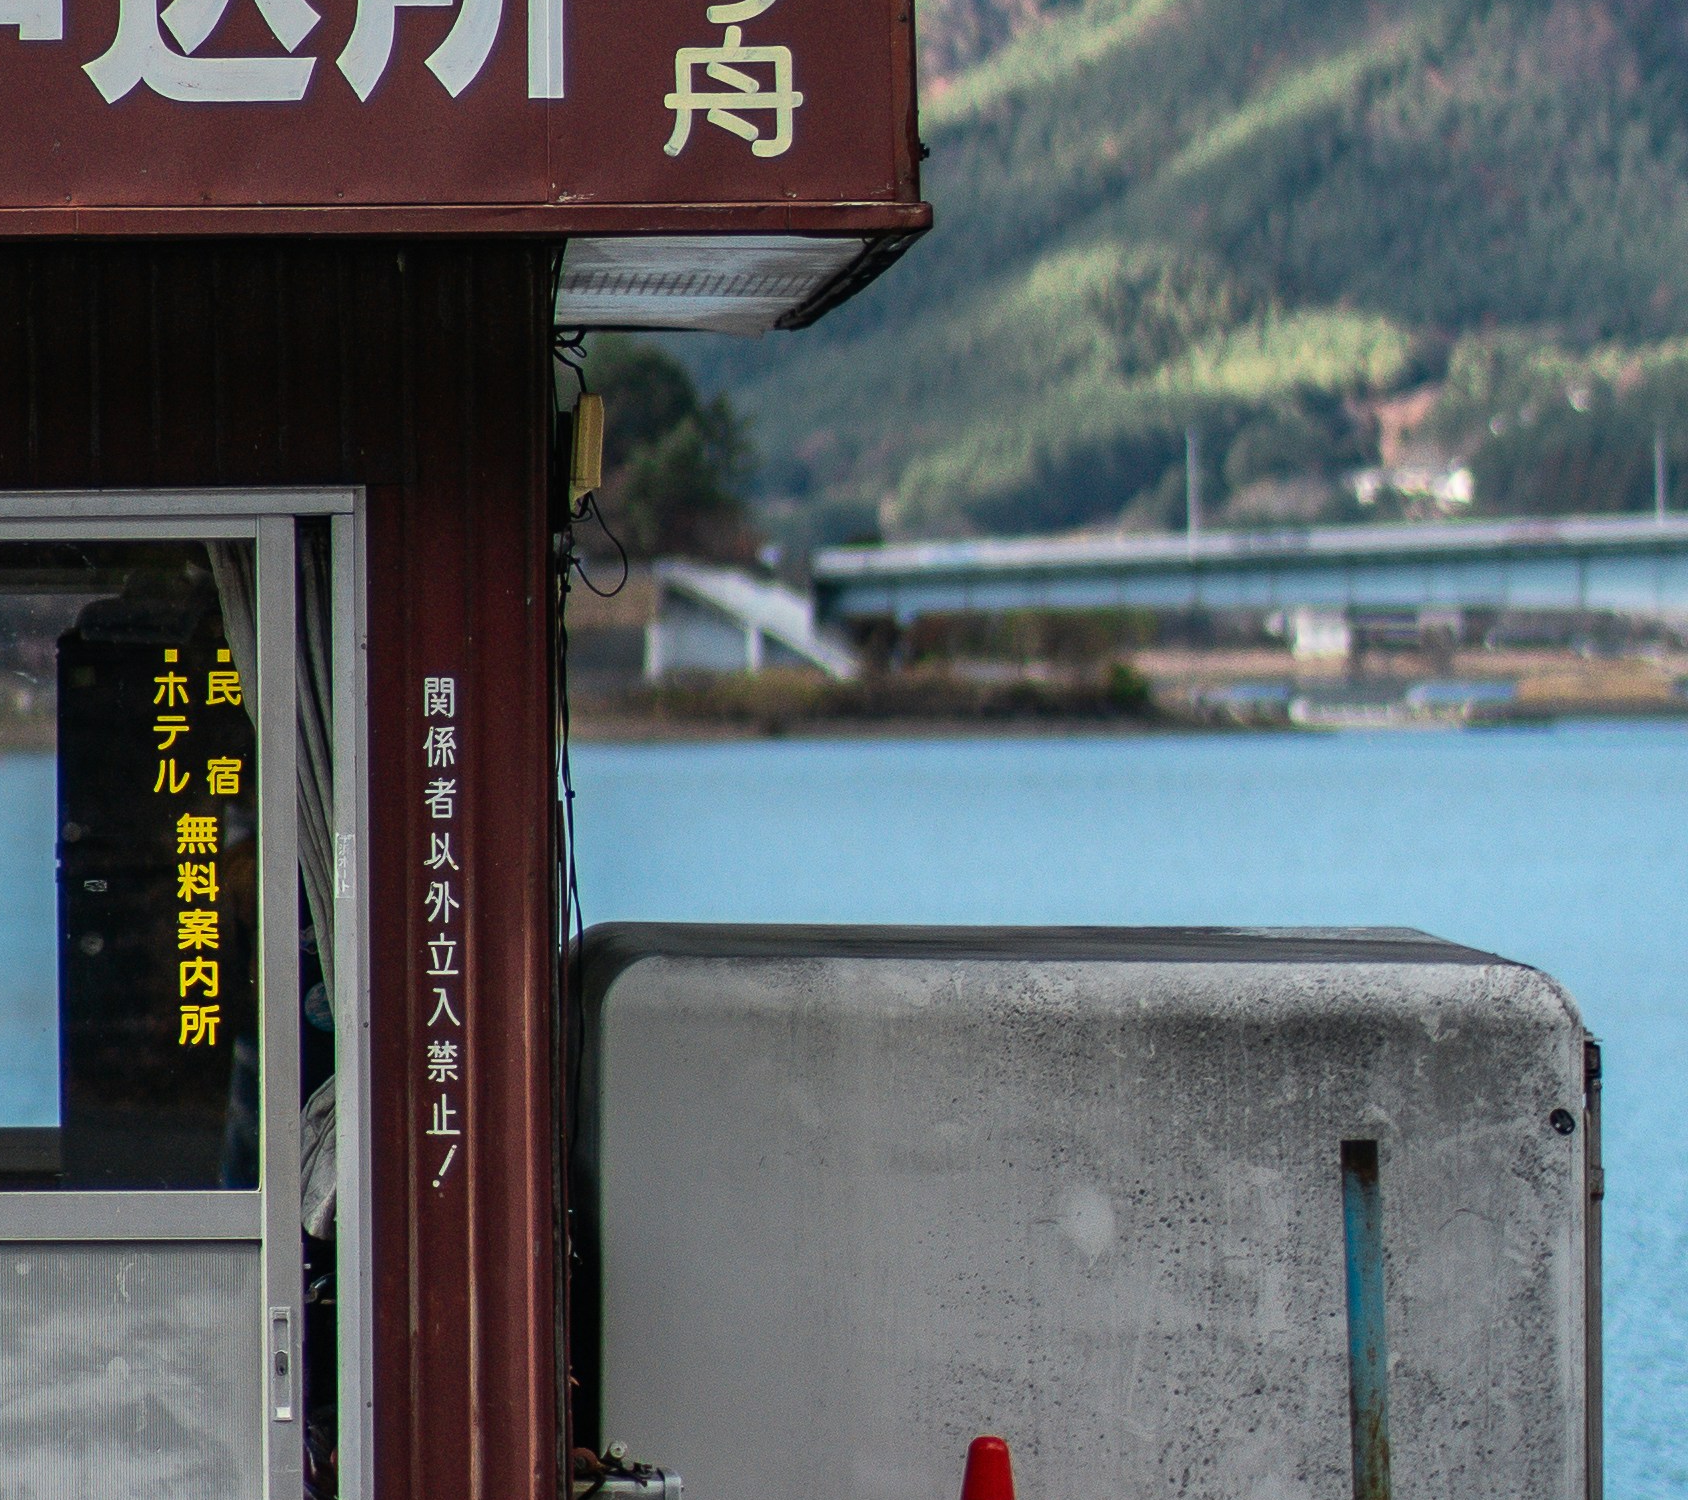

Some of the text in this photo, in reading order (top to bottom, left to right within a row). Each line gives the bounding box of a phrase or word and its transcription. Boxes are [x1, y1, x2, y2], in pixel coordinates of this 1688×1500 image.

[152, 670, 191, 795] ホテル
[205, 670, 243, 796] 民宿
[176, 812, 222, 1047] 無料案内所
